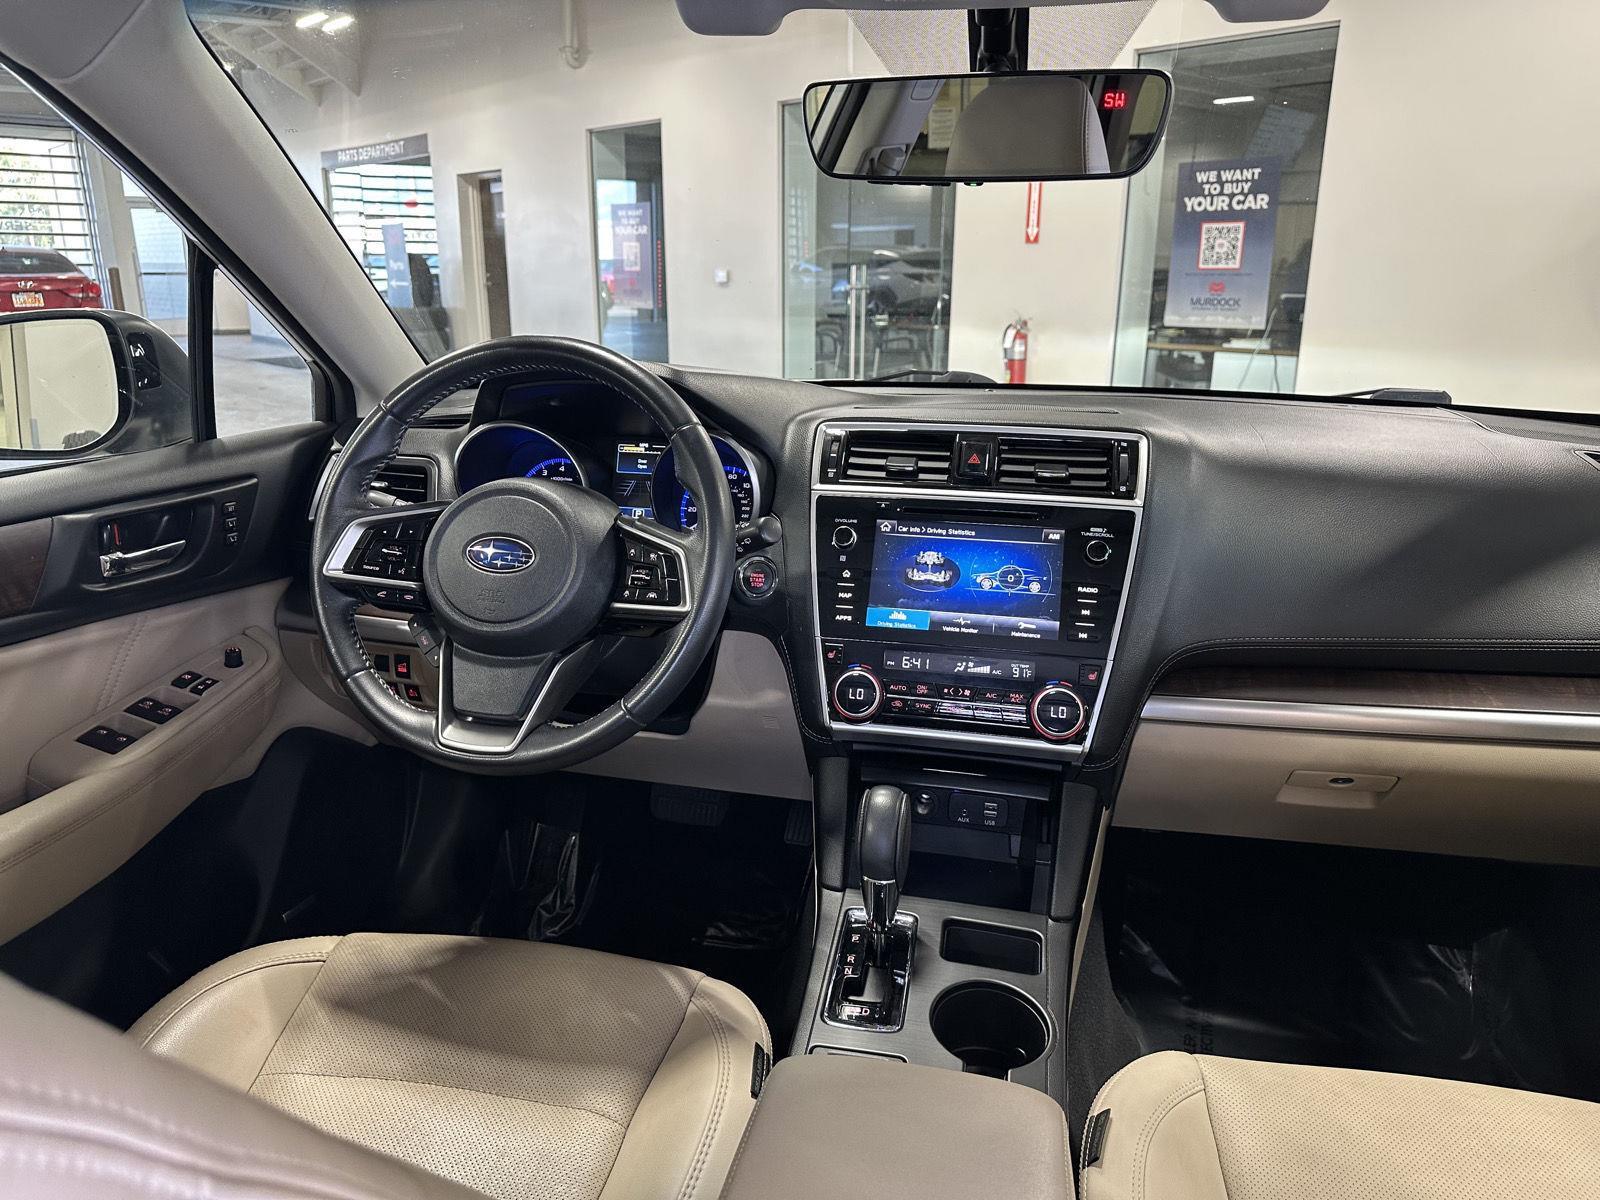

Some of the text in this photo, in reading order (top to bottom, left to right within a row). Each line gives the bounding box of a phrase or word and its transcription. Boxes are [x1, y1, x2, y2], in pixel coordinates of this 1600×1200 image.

[1104, 92, 1125, 108] SW
[337, 141, 405, 162] PARTS DEPARTMENT
[1196, 168, 1261, 182] WE WANT
[1202, 182, 1252, 195] TO BUY
[1183, 193, 1270, 212] YOUR CAR
[1190, 297, 1241, 308] MURDOCK
[926, 528, 946, 536] Driving
[902, 656, 930, 669] 6:41
[848, 688, 864, 700] LO
[1050, 706, 1067, 719] LO
[862, 1008, 870, 1016] D
